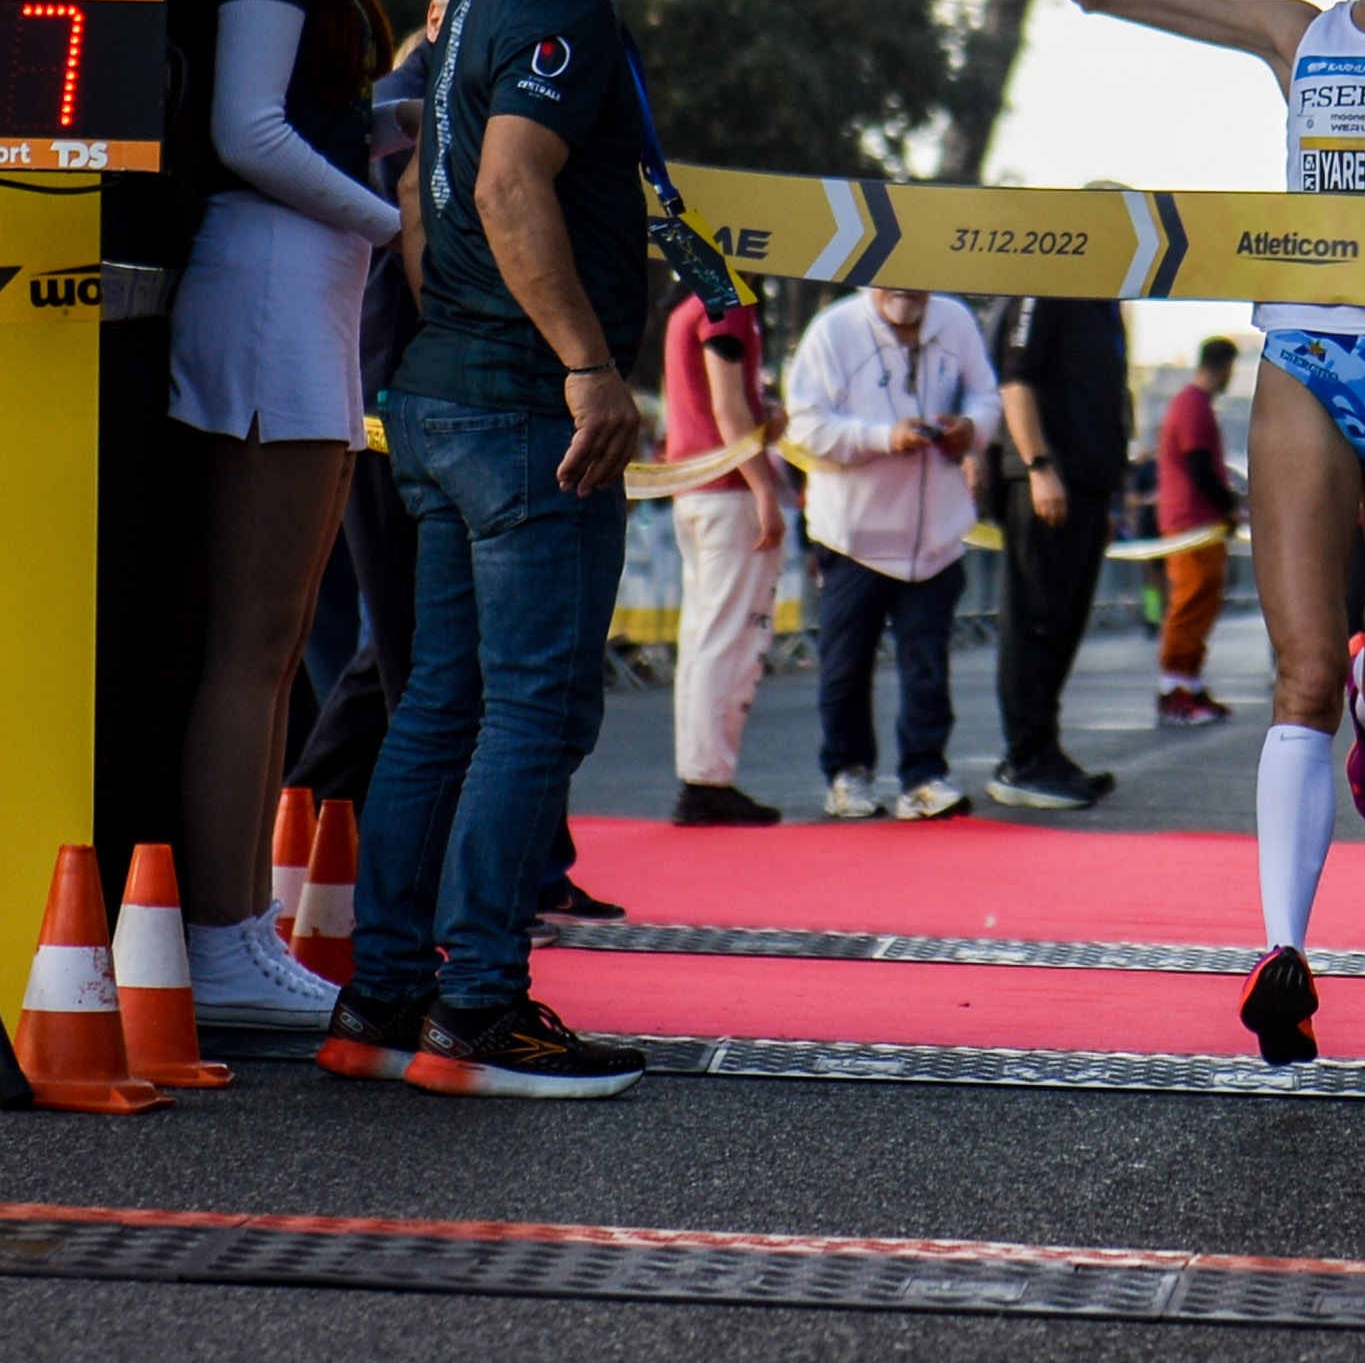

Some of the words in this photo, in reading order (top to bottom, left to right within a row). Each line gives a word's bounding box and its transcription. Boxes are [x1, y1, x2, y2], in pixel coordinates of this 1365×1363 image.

[0, 143, 31, 163] ort
[50, 142, 108, 169] TDS
[950, 229, 1088, 256] 31.12.2022
[1236, 232, 1360, 259] Atleticom
